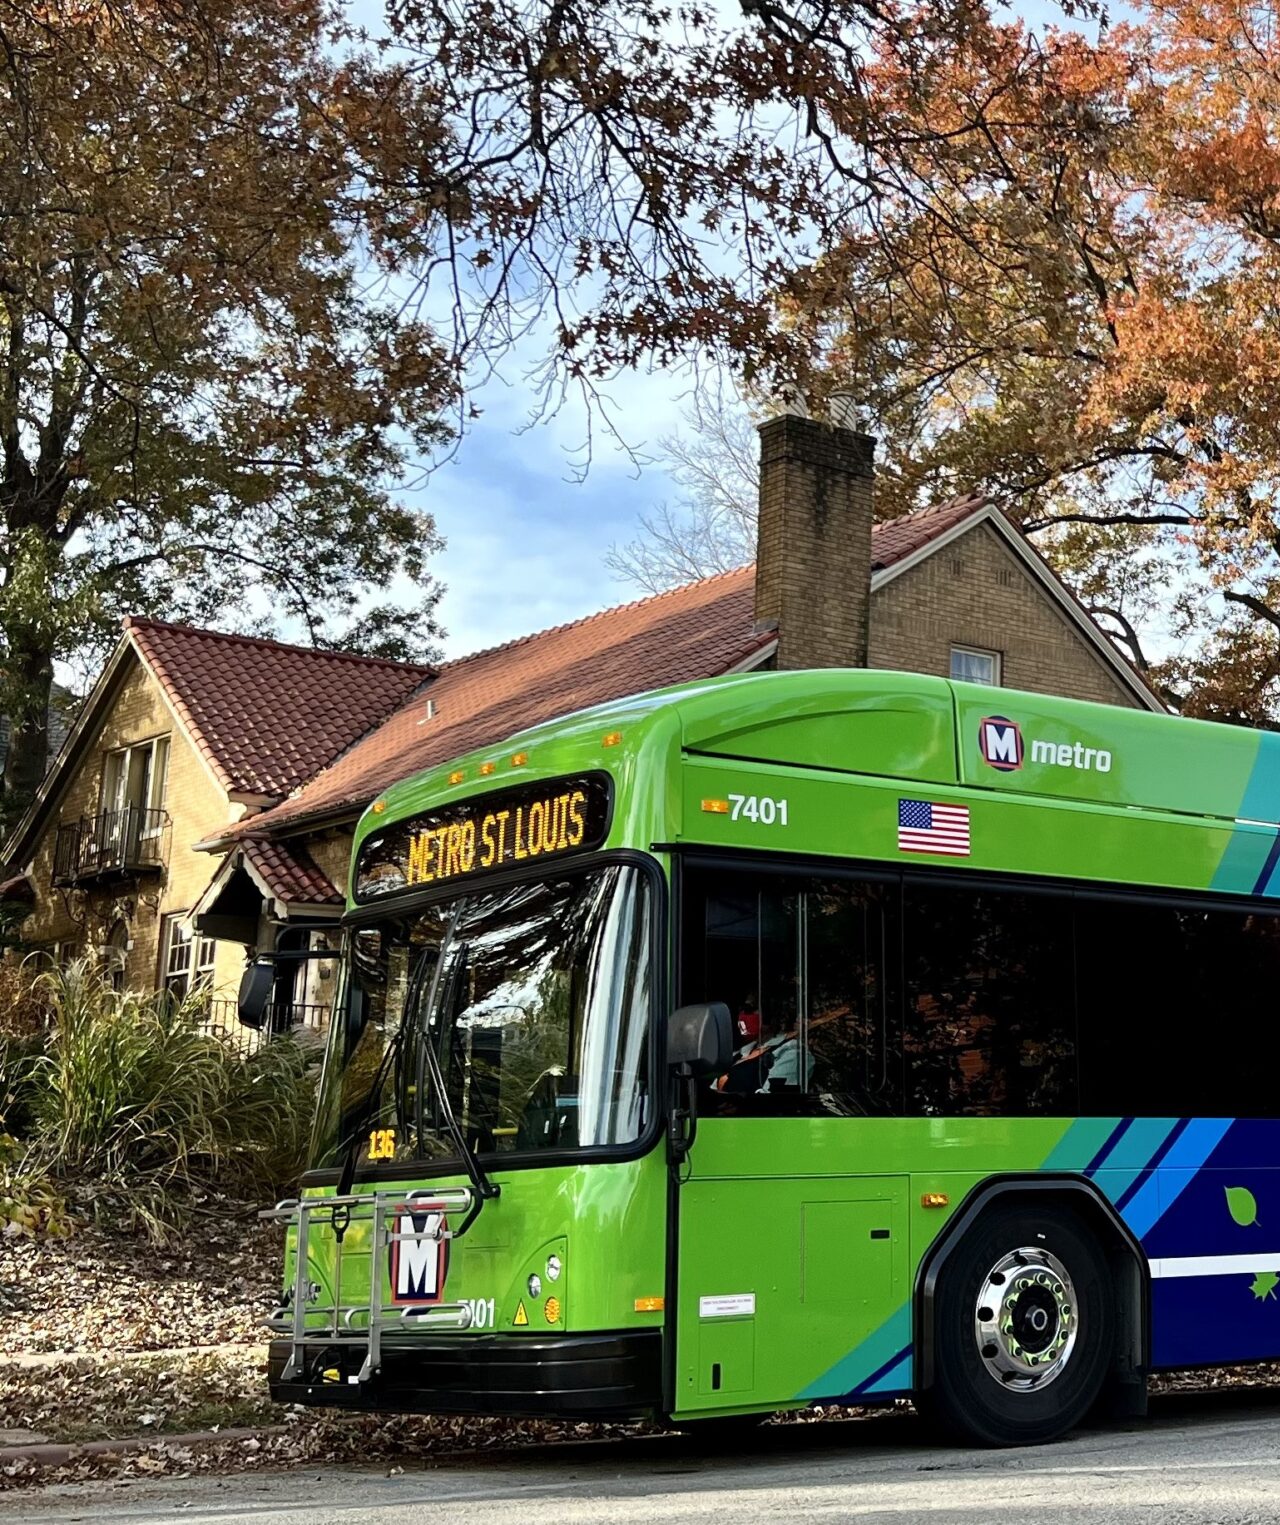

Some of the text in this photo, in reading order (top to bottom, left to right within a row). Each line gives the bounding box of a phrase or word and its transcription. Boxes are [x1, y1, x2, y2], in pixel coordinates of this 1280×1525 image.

[1031, 738, 1111, 773] metro
[728, 794, 787, 826] 7401
[407, 791, 584, 886] METRO ST LOUIS
[368, 1129, 395, 1160] 136
